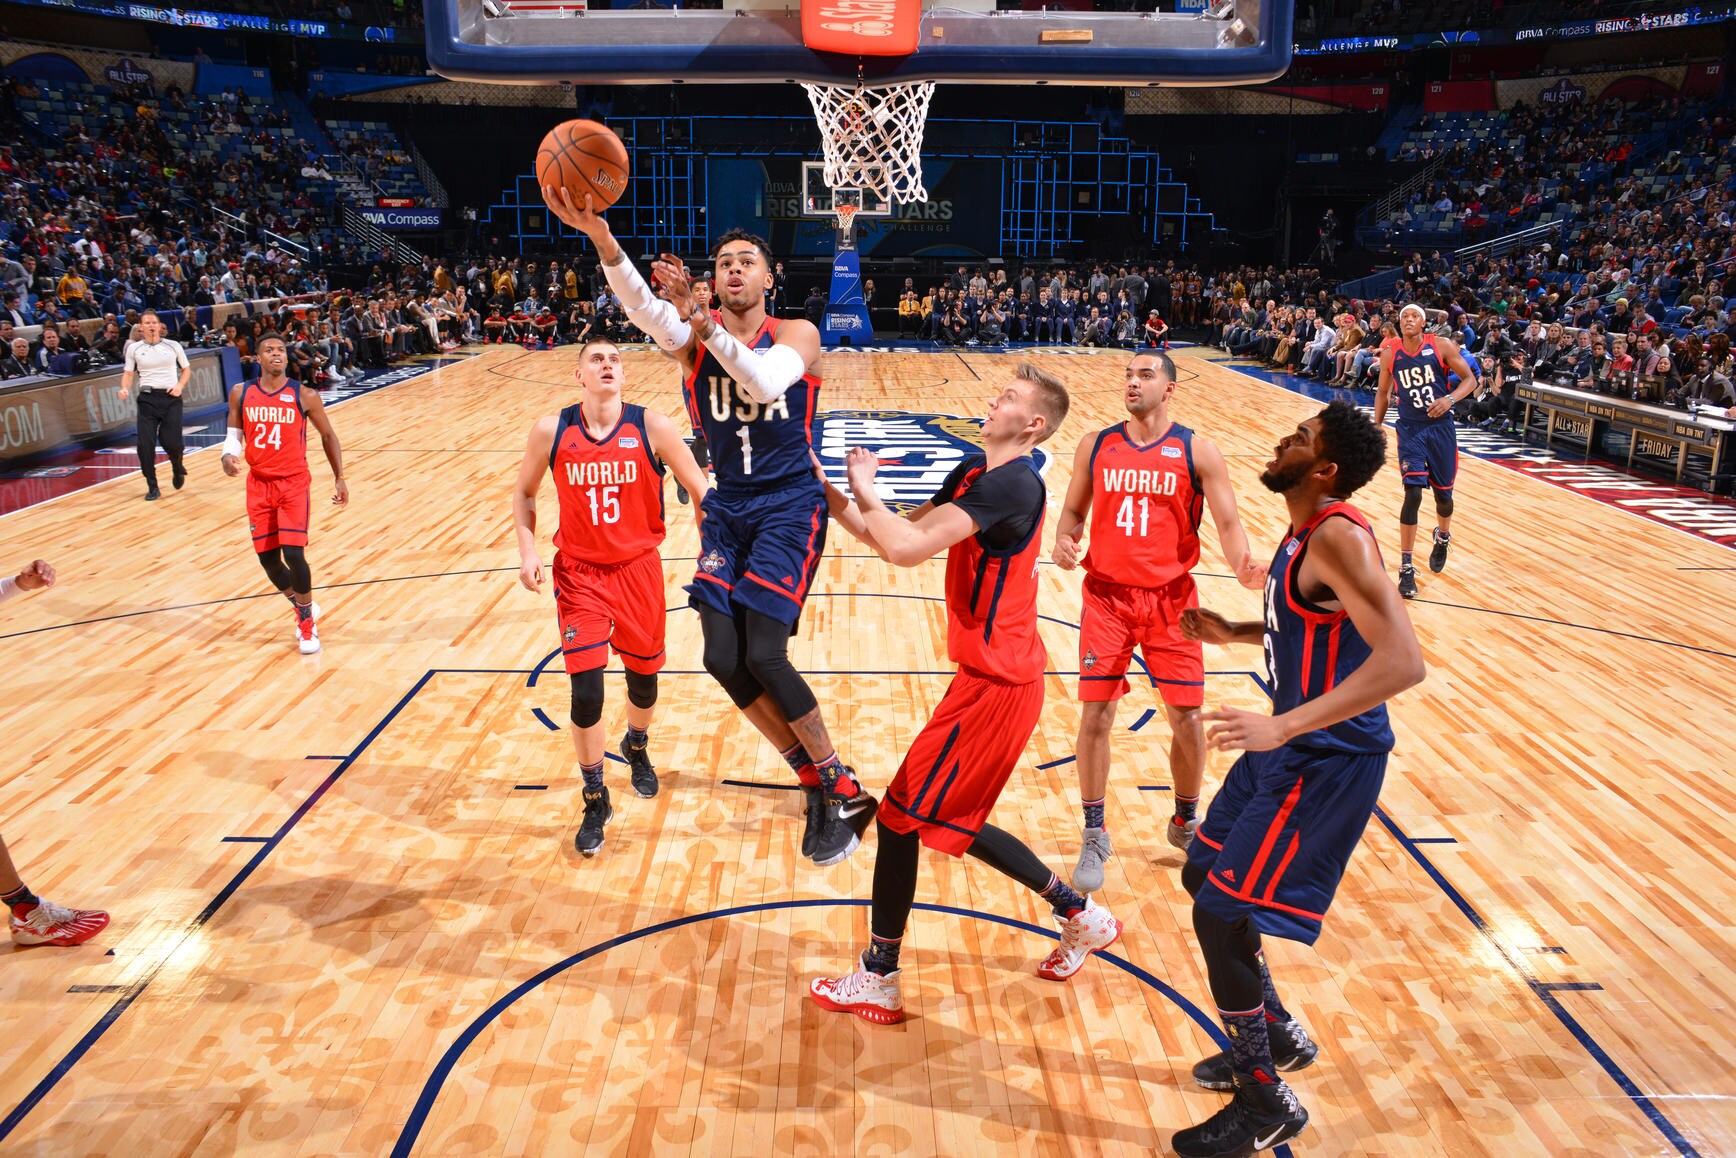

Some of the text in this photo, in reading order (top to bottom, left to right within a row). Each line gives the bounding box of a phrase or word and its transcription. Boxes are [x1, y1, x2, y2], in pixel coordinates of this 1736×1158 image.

[129, 6, 167, 20] RISING
[184, 14, 219, 27] STARS
[300, 23, 326, 36] MVP
[1652, 12, 1689, 27] STARS
[1374, 38, 1399, 49] MVP
[1706, 65, 1720, 75] 121
[387, 213, 440, 226] Compass
[1398, 364, 1436, 389] USA
[708, 376, 790, 423] USA
[1409, 386, 1435, 408] 33
[245, 406, 295, 424] WORLD
[1554, 416, 1567, 431] ALL
[254, 423, 282, 450] 24
[1676, 425, 1704, 439] NBA ON TNT
[736, 425, 752, 475] 1
[1642, 439, 1673, 459] FRIDAY
[565, 461, 638, 486] WORLD
[1103, 468, 1177, 496] WORLD
[585, 487, 620, 526] 15
[1116, 496, 1149, 537] 41
